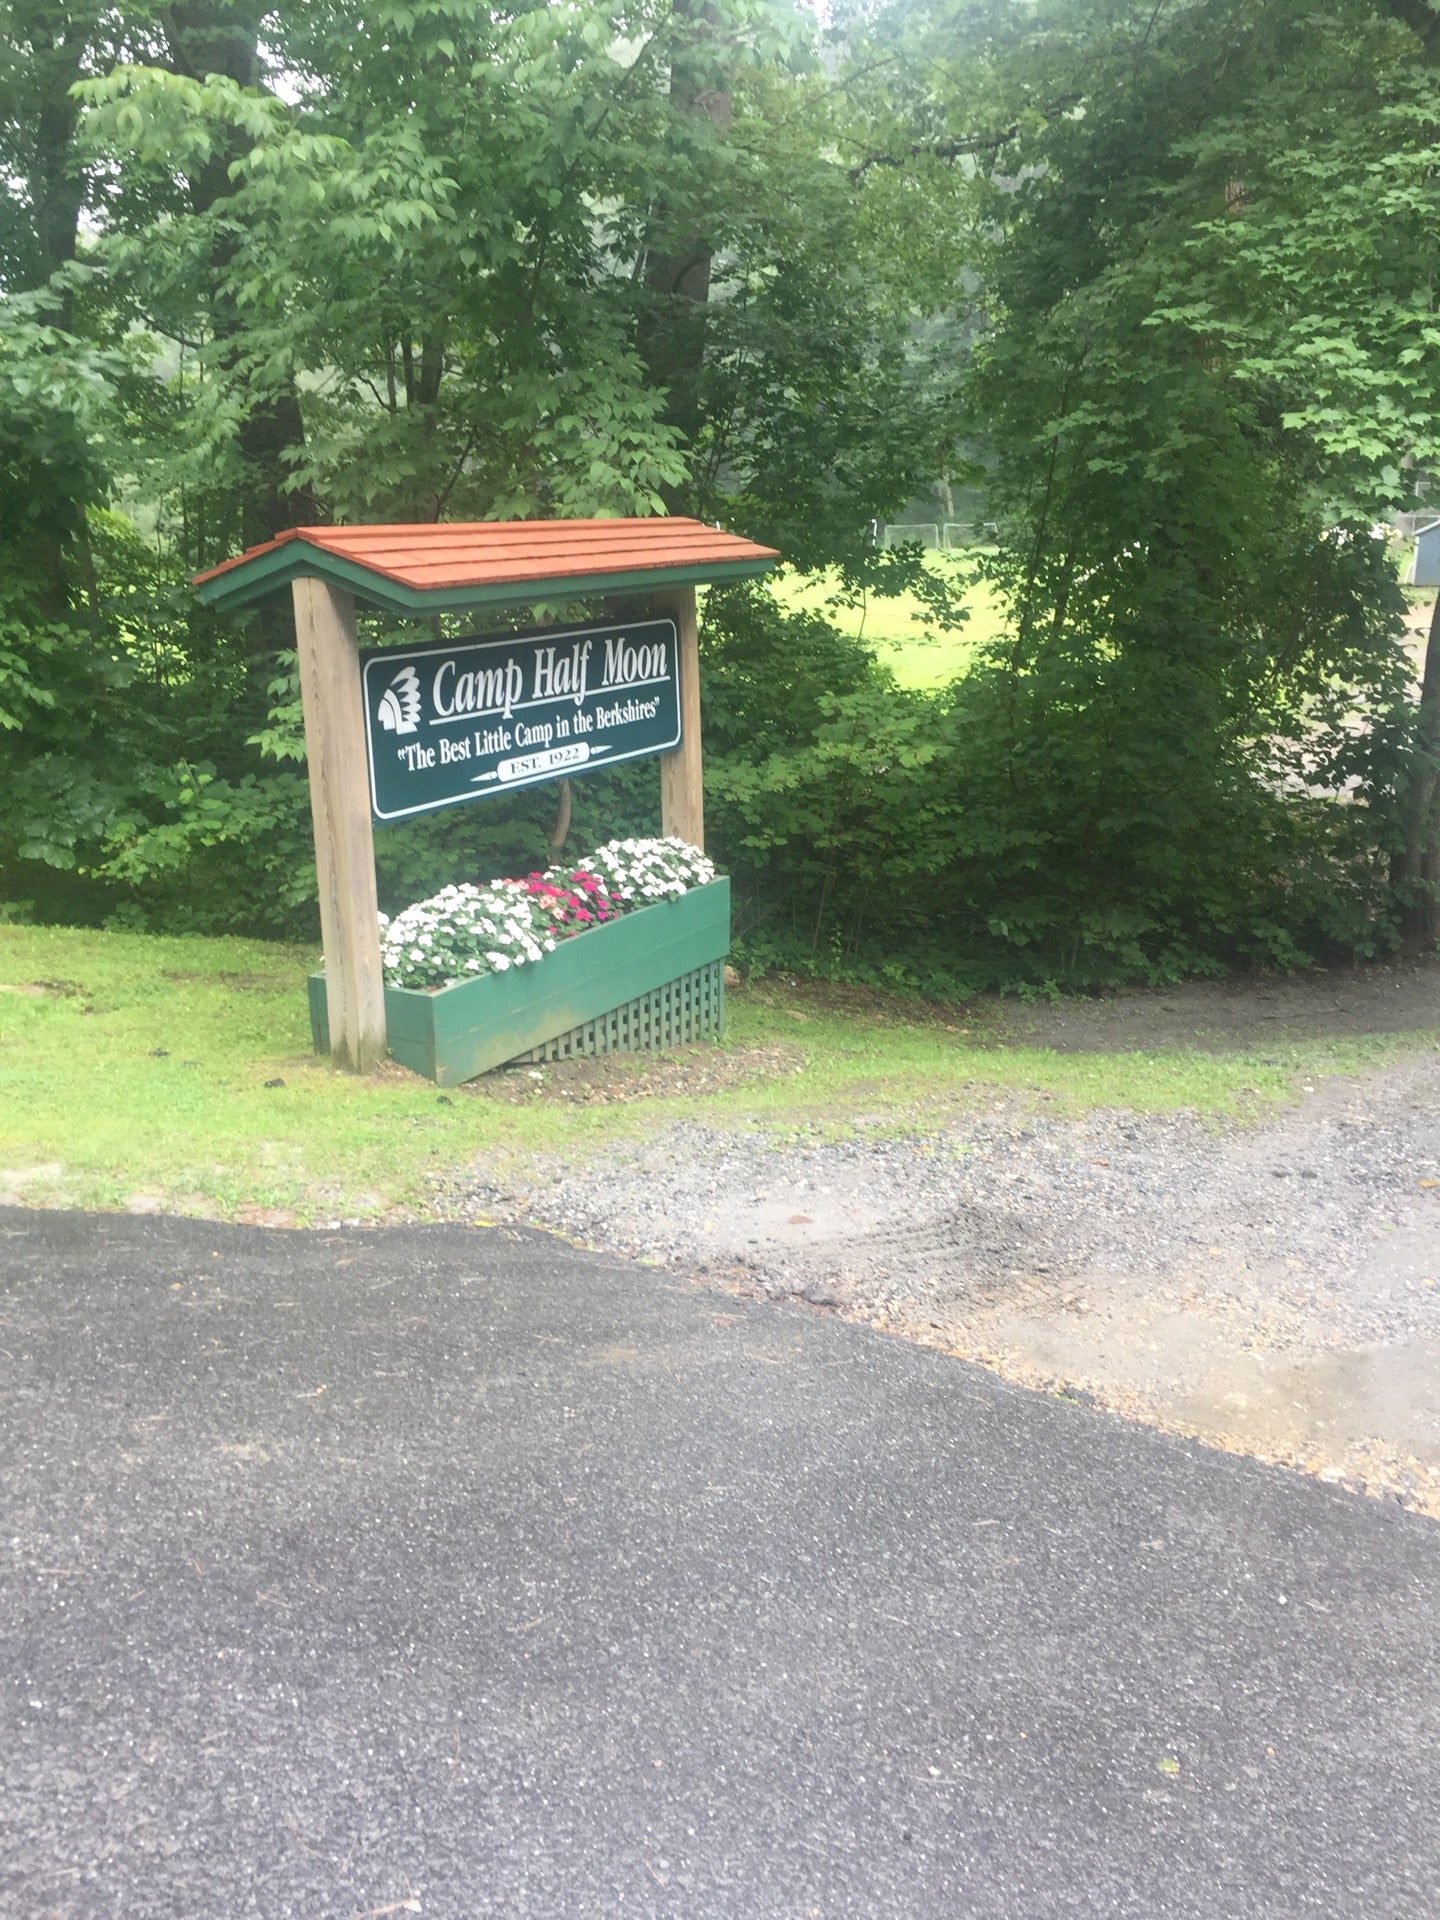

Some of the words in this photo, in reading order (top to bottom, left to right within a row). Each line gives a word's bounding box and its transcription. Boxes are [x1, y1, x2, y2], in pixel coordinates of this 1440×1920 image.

[433, 660, 523, 719] Camp
[532, 640, 593, 706] Half
[601, 637, 668, 686] Moon
[438, 736, 471, 764] Best
[474, 724, 512, 756] Little
[515, 722, 553, 748] Camp
[556, 714, 570, 738] in
[573, 709, 593, 734] the
[510, 759, 541, 775] EST.
[549, 747, 580, 765] 1922
